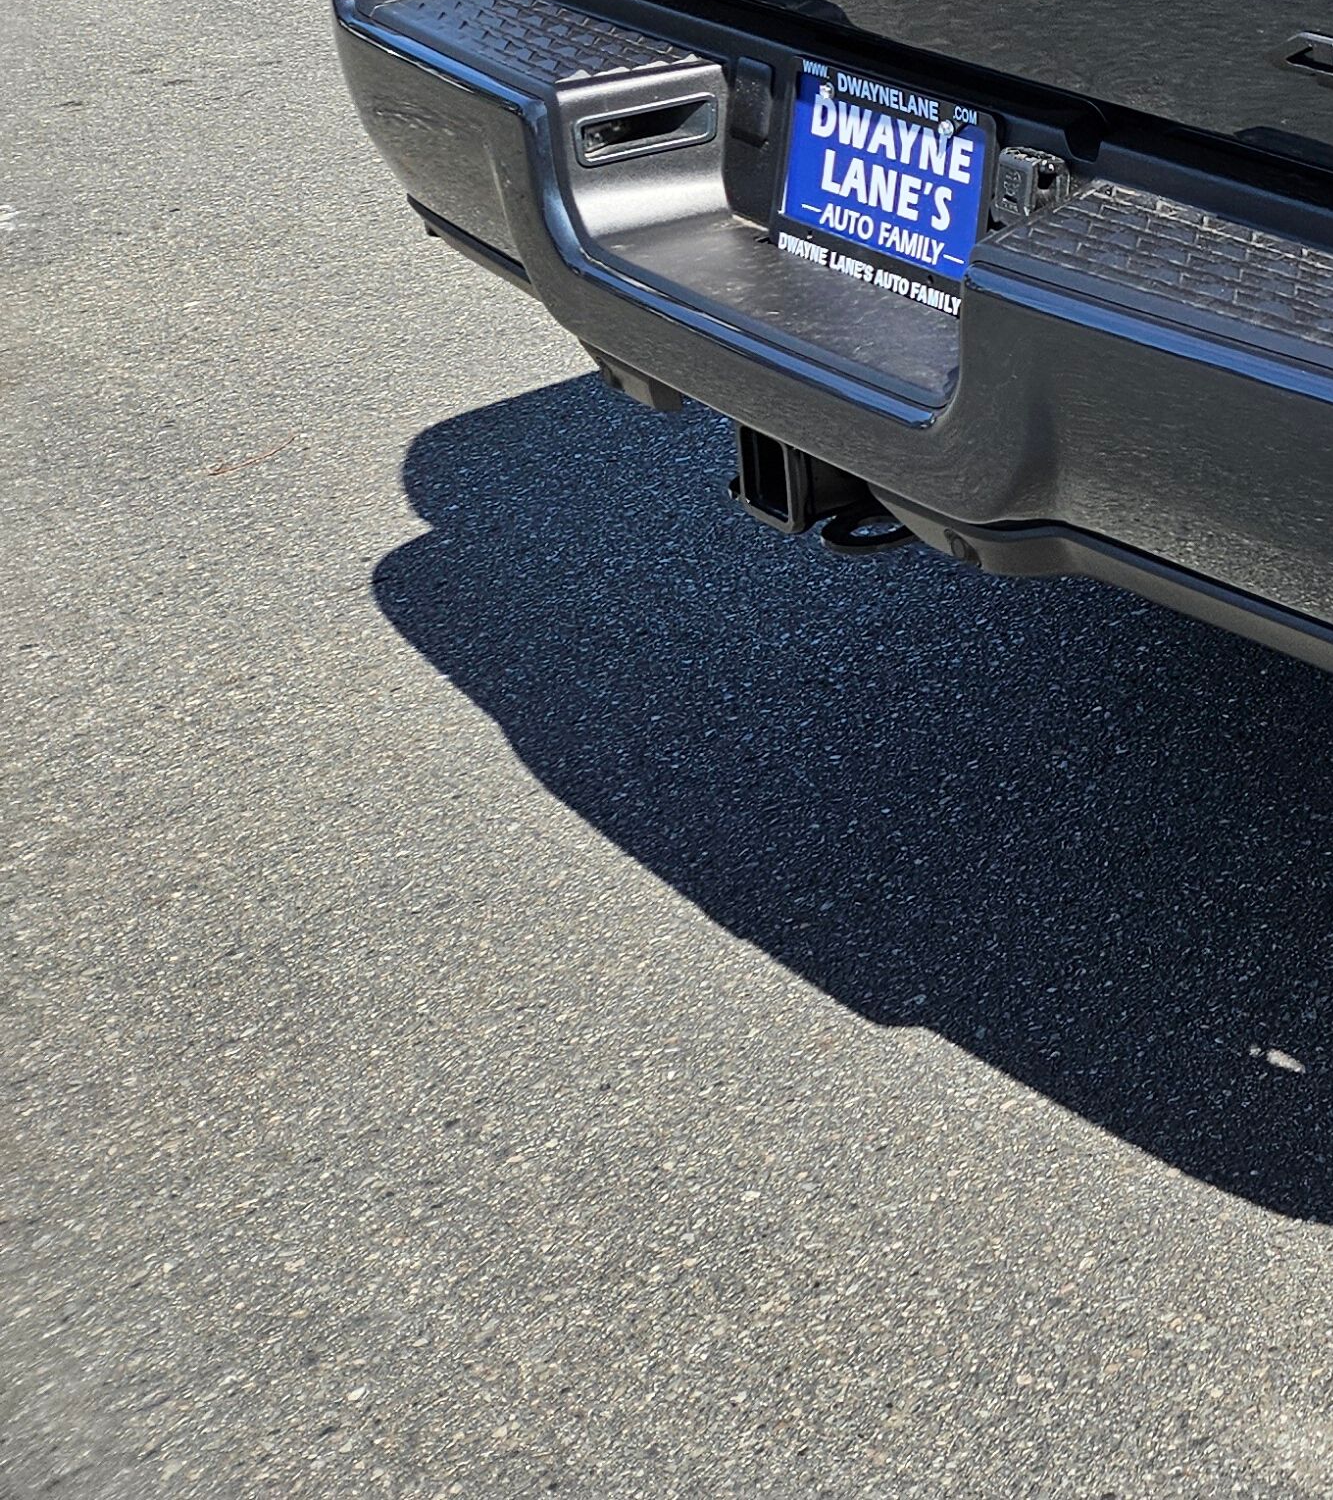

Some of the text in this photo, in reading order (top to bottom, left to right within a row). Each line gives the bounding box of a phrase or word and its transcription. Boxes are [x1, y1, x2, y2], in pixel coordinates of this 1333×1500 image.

[811, 93, 974, 184] DWAYNE
[837, 73, 939, 122] DWAYNELANE
[821, 149, 952, 231] LANE'S
[778, 232, 961, 316] DWAYNE LANE'S AUTO FAMILY
[819, 203, 944, 265] AUTO FAMILY
